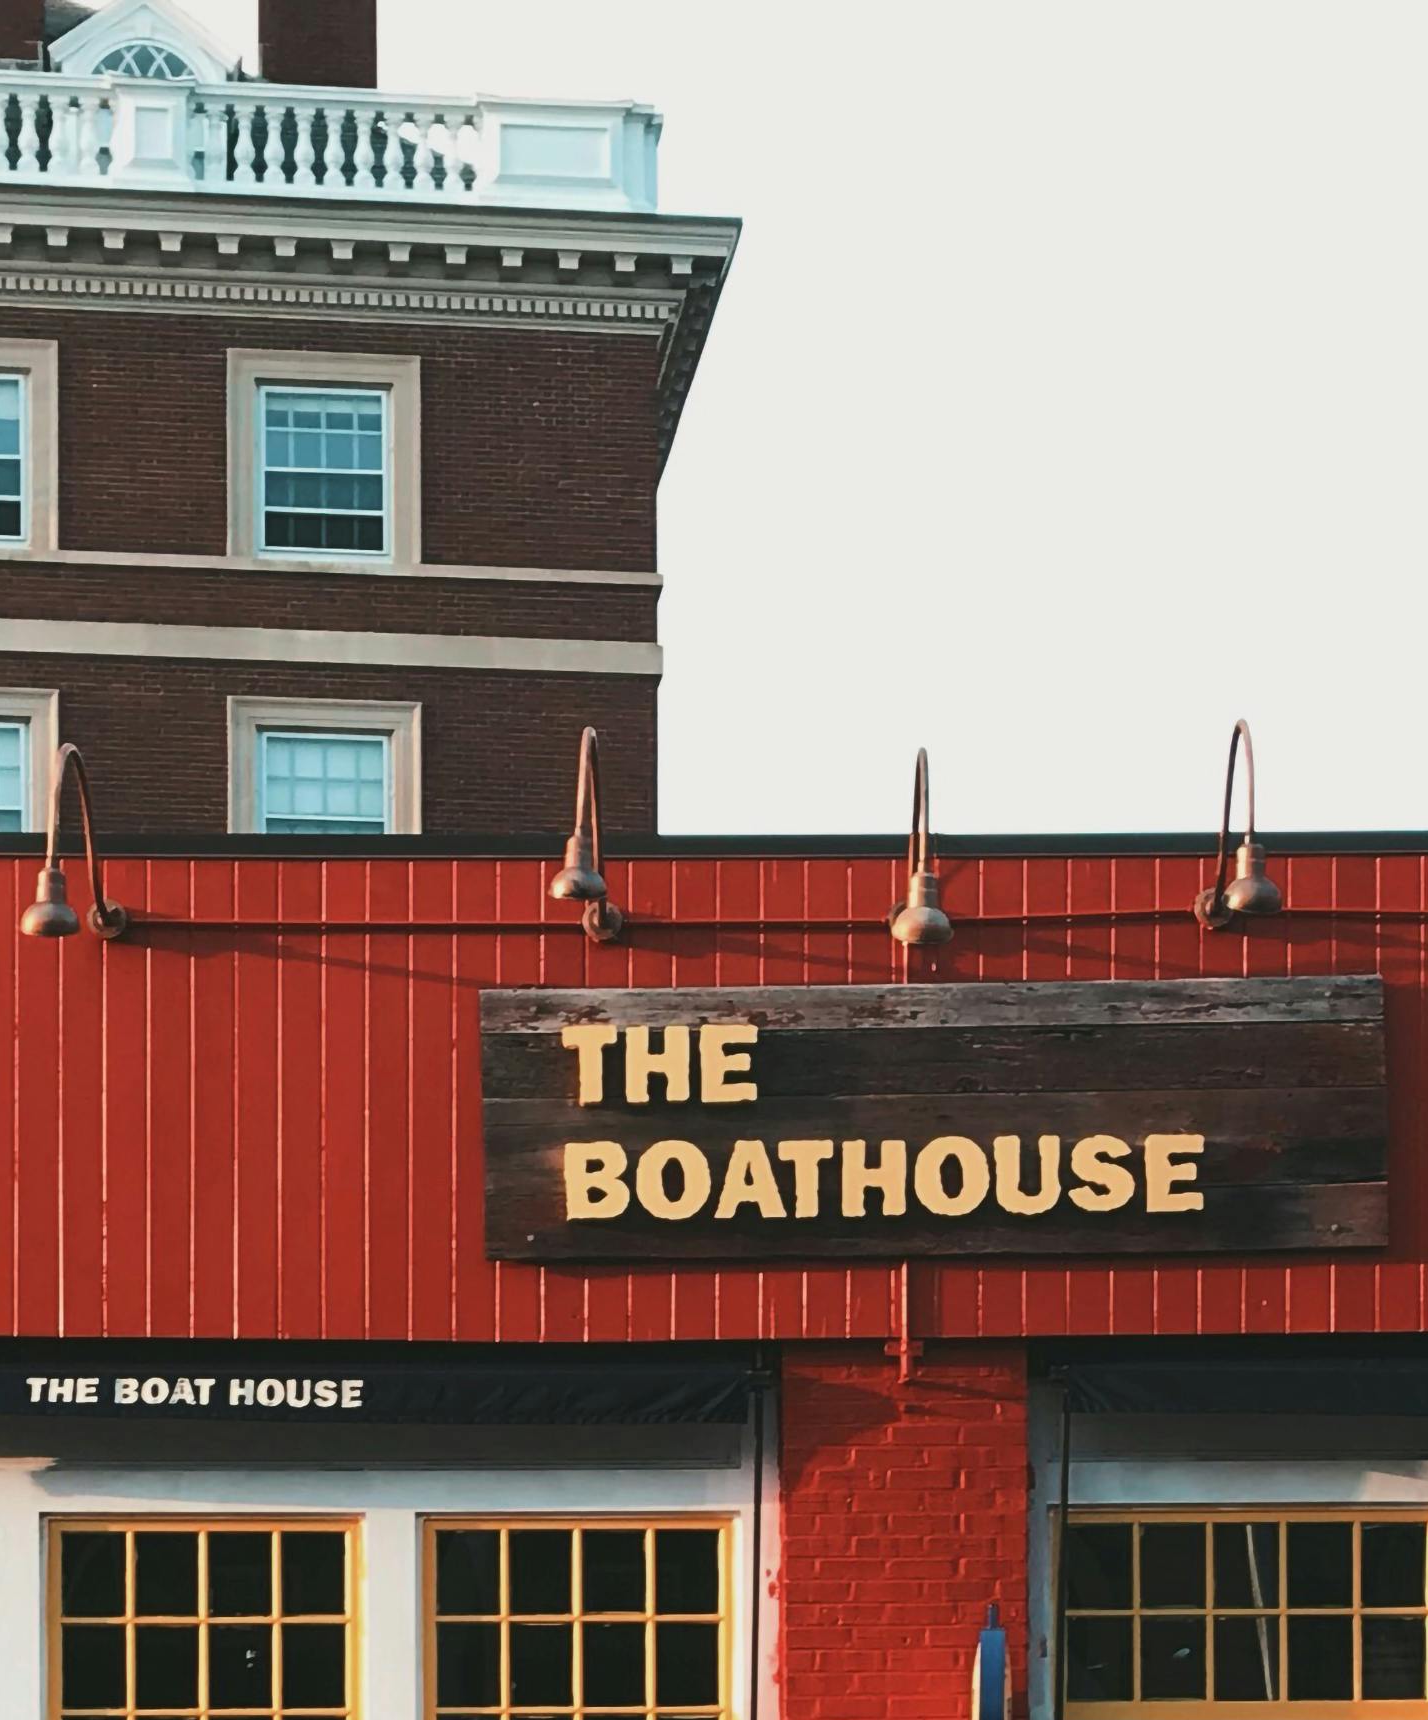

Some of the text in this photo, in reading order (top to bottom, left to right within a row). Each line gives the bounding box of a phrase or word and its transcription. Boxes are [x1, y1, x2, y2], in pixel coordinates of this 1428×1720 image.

[562, 1024, 759, 1106] THE
[564, 1133, 1205, 1221] BOATHOUSE
[26, 1377, 364, 1408] THE BOAT HOUSE
